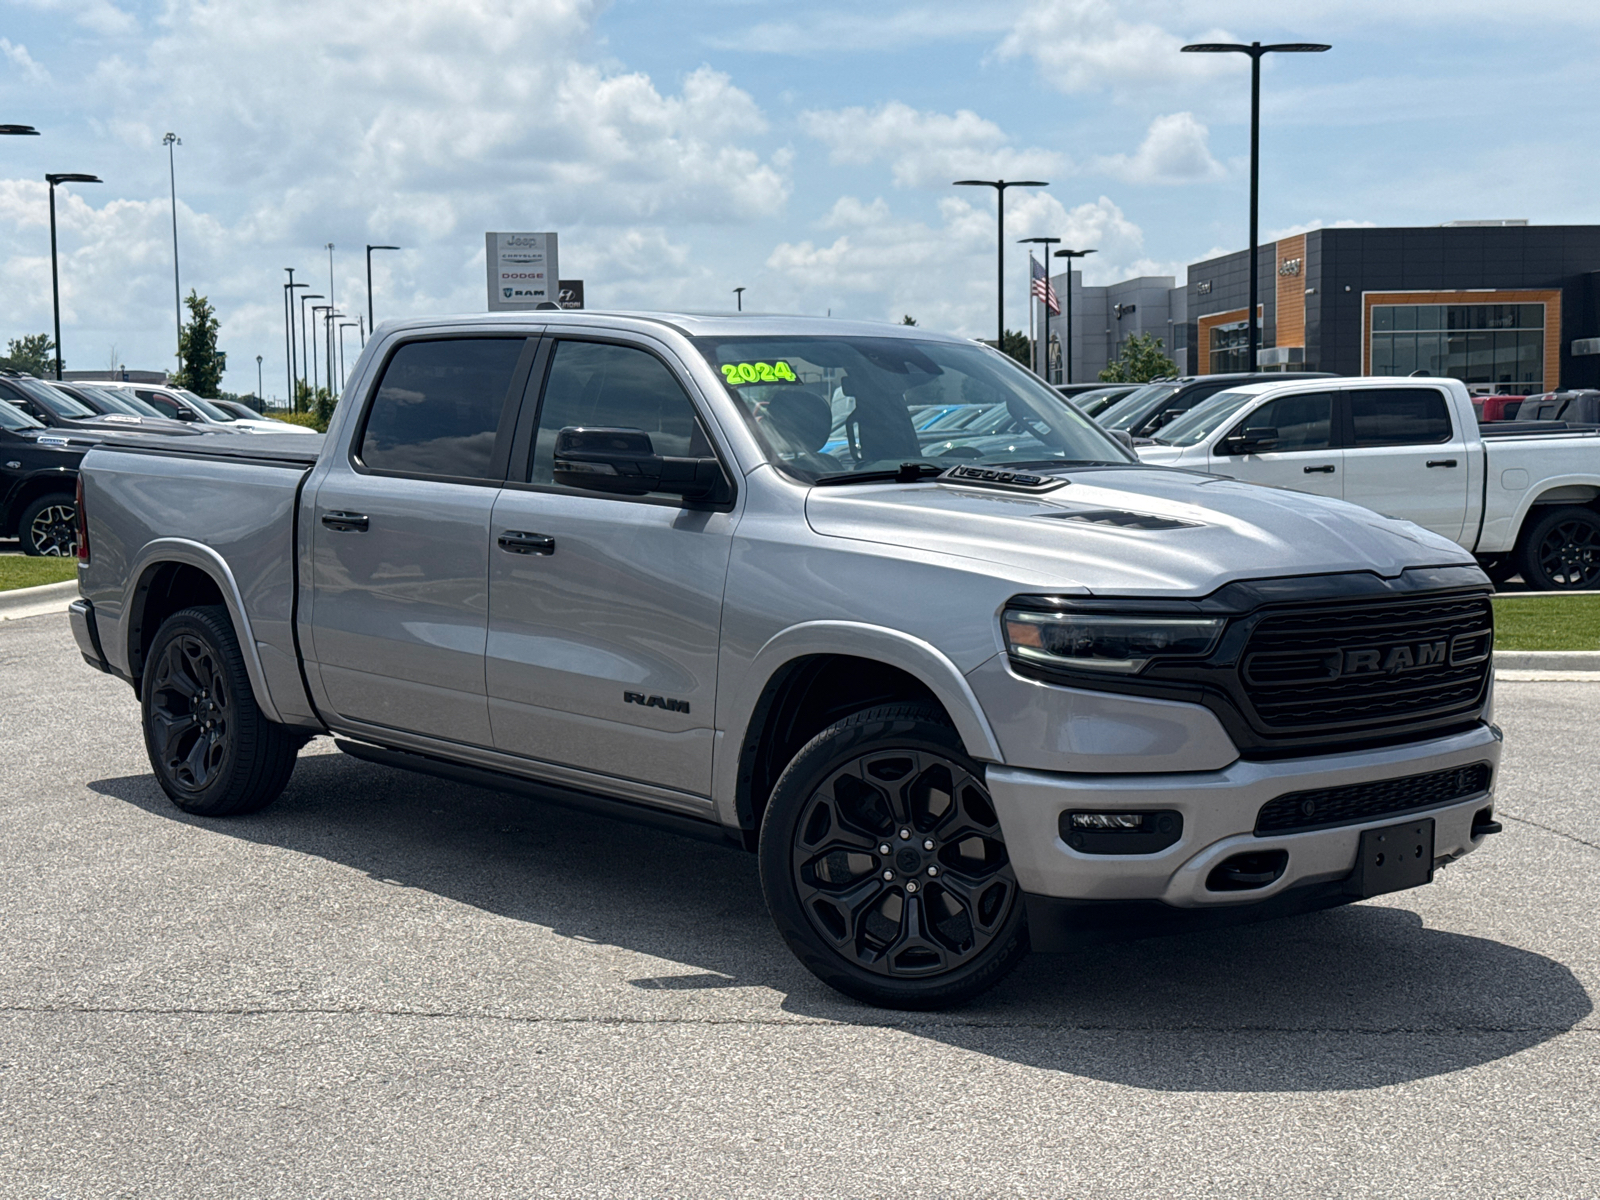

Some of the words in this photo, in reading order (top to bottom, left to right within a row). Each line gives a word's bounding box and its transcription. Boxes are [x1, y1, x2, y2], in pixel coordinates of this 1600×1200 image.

[507, 235, 536, 248] Jeep
[721, 361, 797, 385] 2024
[960, 466, 1016, 480] 1500
[1346, 641, 1447, 673] RAM
[623, 690, 691, 714] RAM
